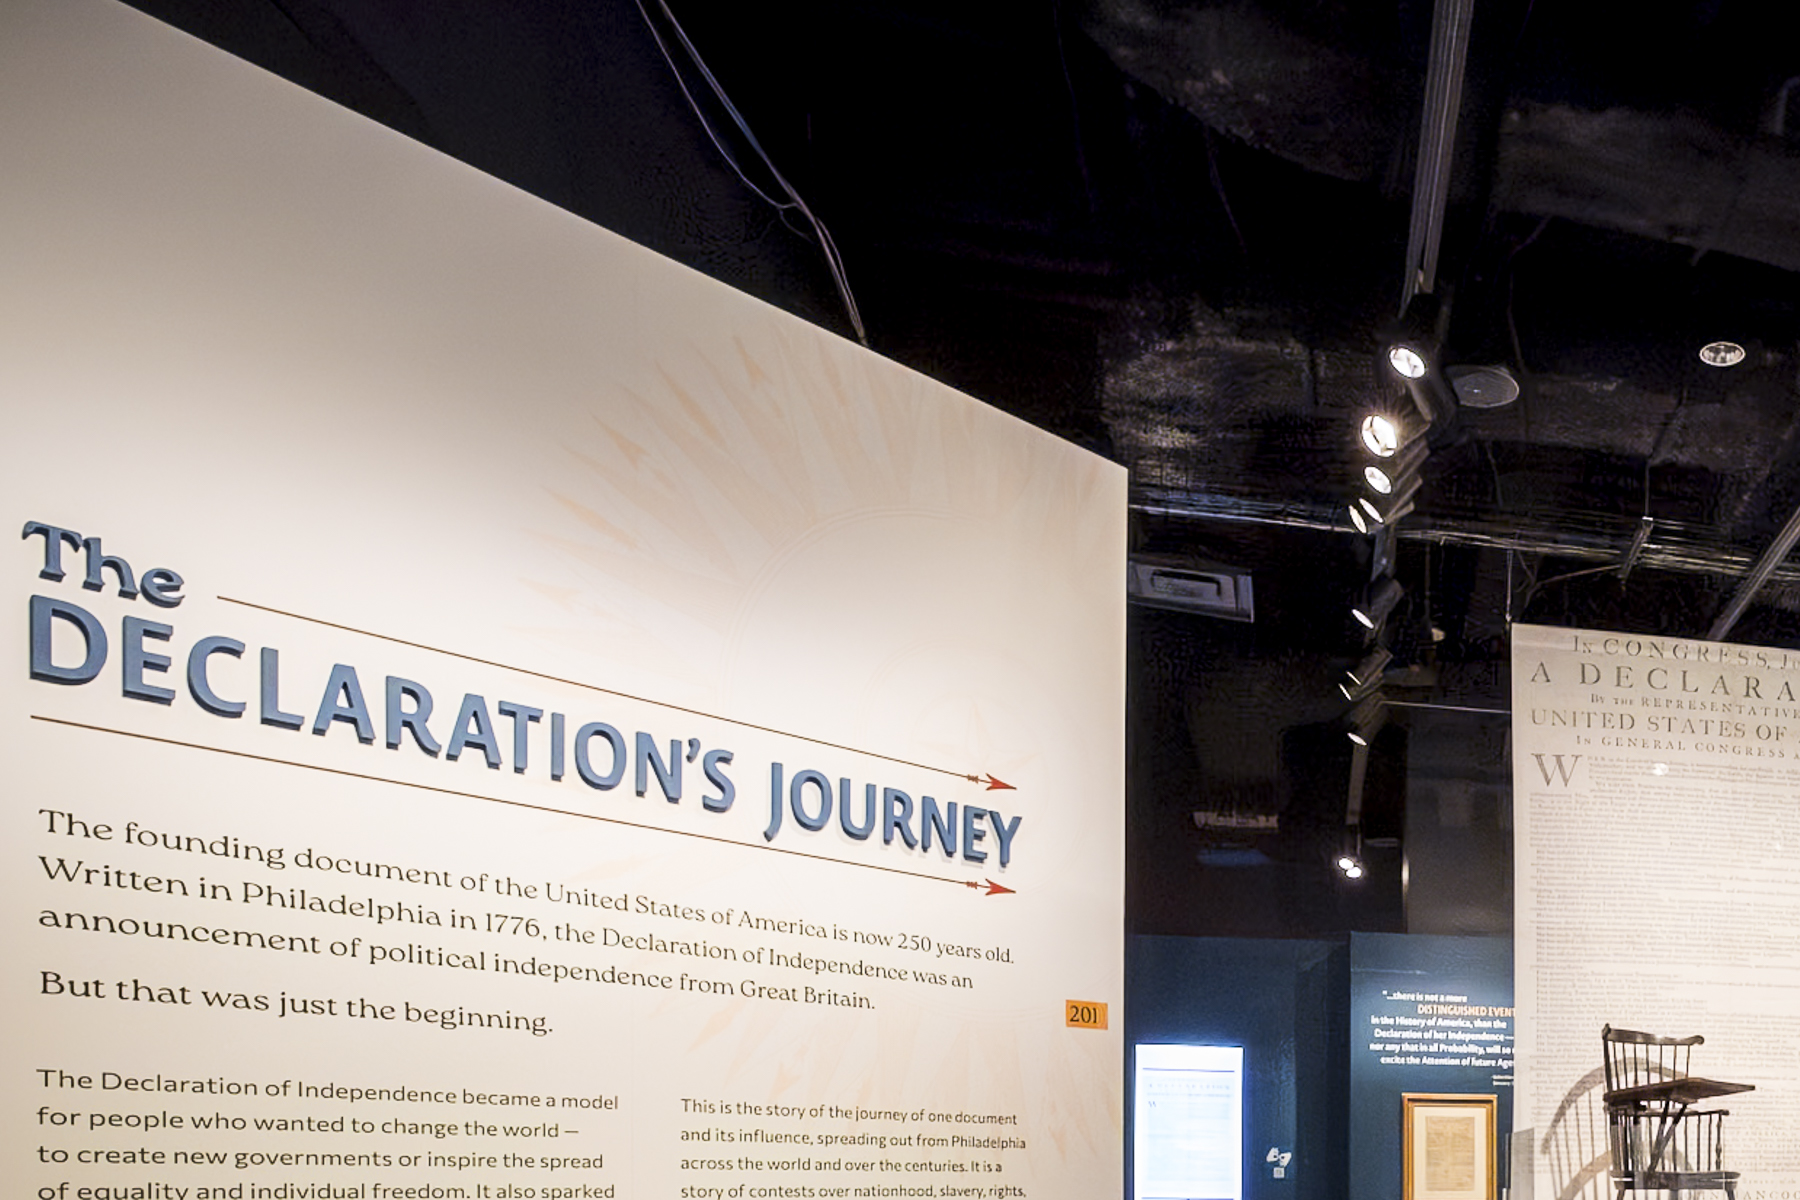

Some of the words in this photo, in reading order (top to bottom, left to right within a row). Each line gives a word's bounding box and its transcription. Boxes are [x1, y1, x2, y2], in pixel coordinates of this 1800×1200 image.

[22, 519, 186, 609] The
[1531, 661, 1551, 683] A
[28, 594, 738, 814] DECLARATION’S
[763, 762, 1022, 868] JOURNEY
[1531, 709, 1635, 730] UNITED
[1647, 716, 1745, 738] STATES
[1756, 724, 1788, 741] OF
[1601, 736, 1686, 751] GENERAL
[1695, 742, 1785, 758] CONGRESS
[38, 809, 112, 840] The
[126, 822, 286, 862] founding
[294, 848, 452, 887] document
[460, 874, 488, 892] of
[495, 877, 537, 899] the
[546, 882, 628, 912] United
[635, 896, 705, 922] States
[712, 909, 734, 925] of
[738, 911, 827, 938] America
[834, 924, 848, 940] is
[854, 932, 893, 946] now
[898, 933, 931, 952] 250
[936, 943, 982, 959] years
[985, 947, 1014, 964] old.
[38, 855, 189, 896] Written
[200, 877, 232, 901] in
[242, 882, 442, 926] Philadelphia
[451, 909, 477, 930] in
[486, 913, 547, 941] 1776,
[555, 923, 595, 944] the
[603, 928, 737, 961] Declaration
[742, 947, 765, 964] of
[770, 948, 908, 981] Independence
[913, 970, 947, 985] was
[952, 976, 973, 988] an
[39, 910, 321, 954] announcement
[330, 938, 362, 957] of
[370, 944, 485, 970] political
[495, 953, 672, 989] independence
[680, 973, 734, 995] from
[740, 980, 798, 1002] Great
[804, 986, 875, 1009] Britain.
[40, 971, 106, 998] But
[116, 979, 192, 1005] that
[201, 991, 269, 1011] was
[278, 992, 338, 1018] just
[347, 998, 395, 1020] the
[405, 1002, 552, 1036] beginning.
[1069, 1005, 1097, 1024] 201
[1417, 1003, 1487, 1017] DISTINGUISHED
[1374, 1028, 1422, 1039] Declaration
[1423, 1029, 1433, 1039] of
[1433, 1030, 1447, 1040] her
